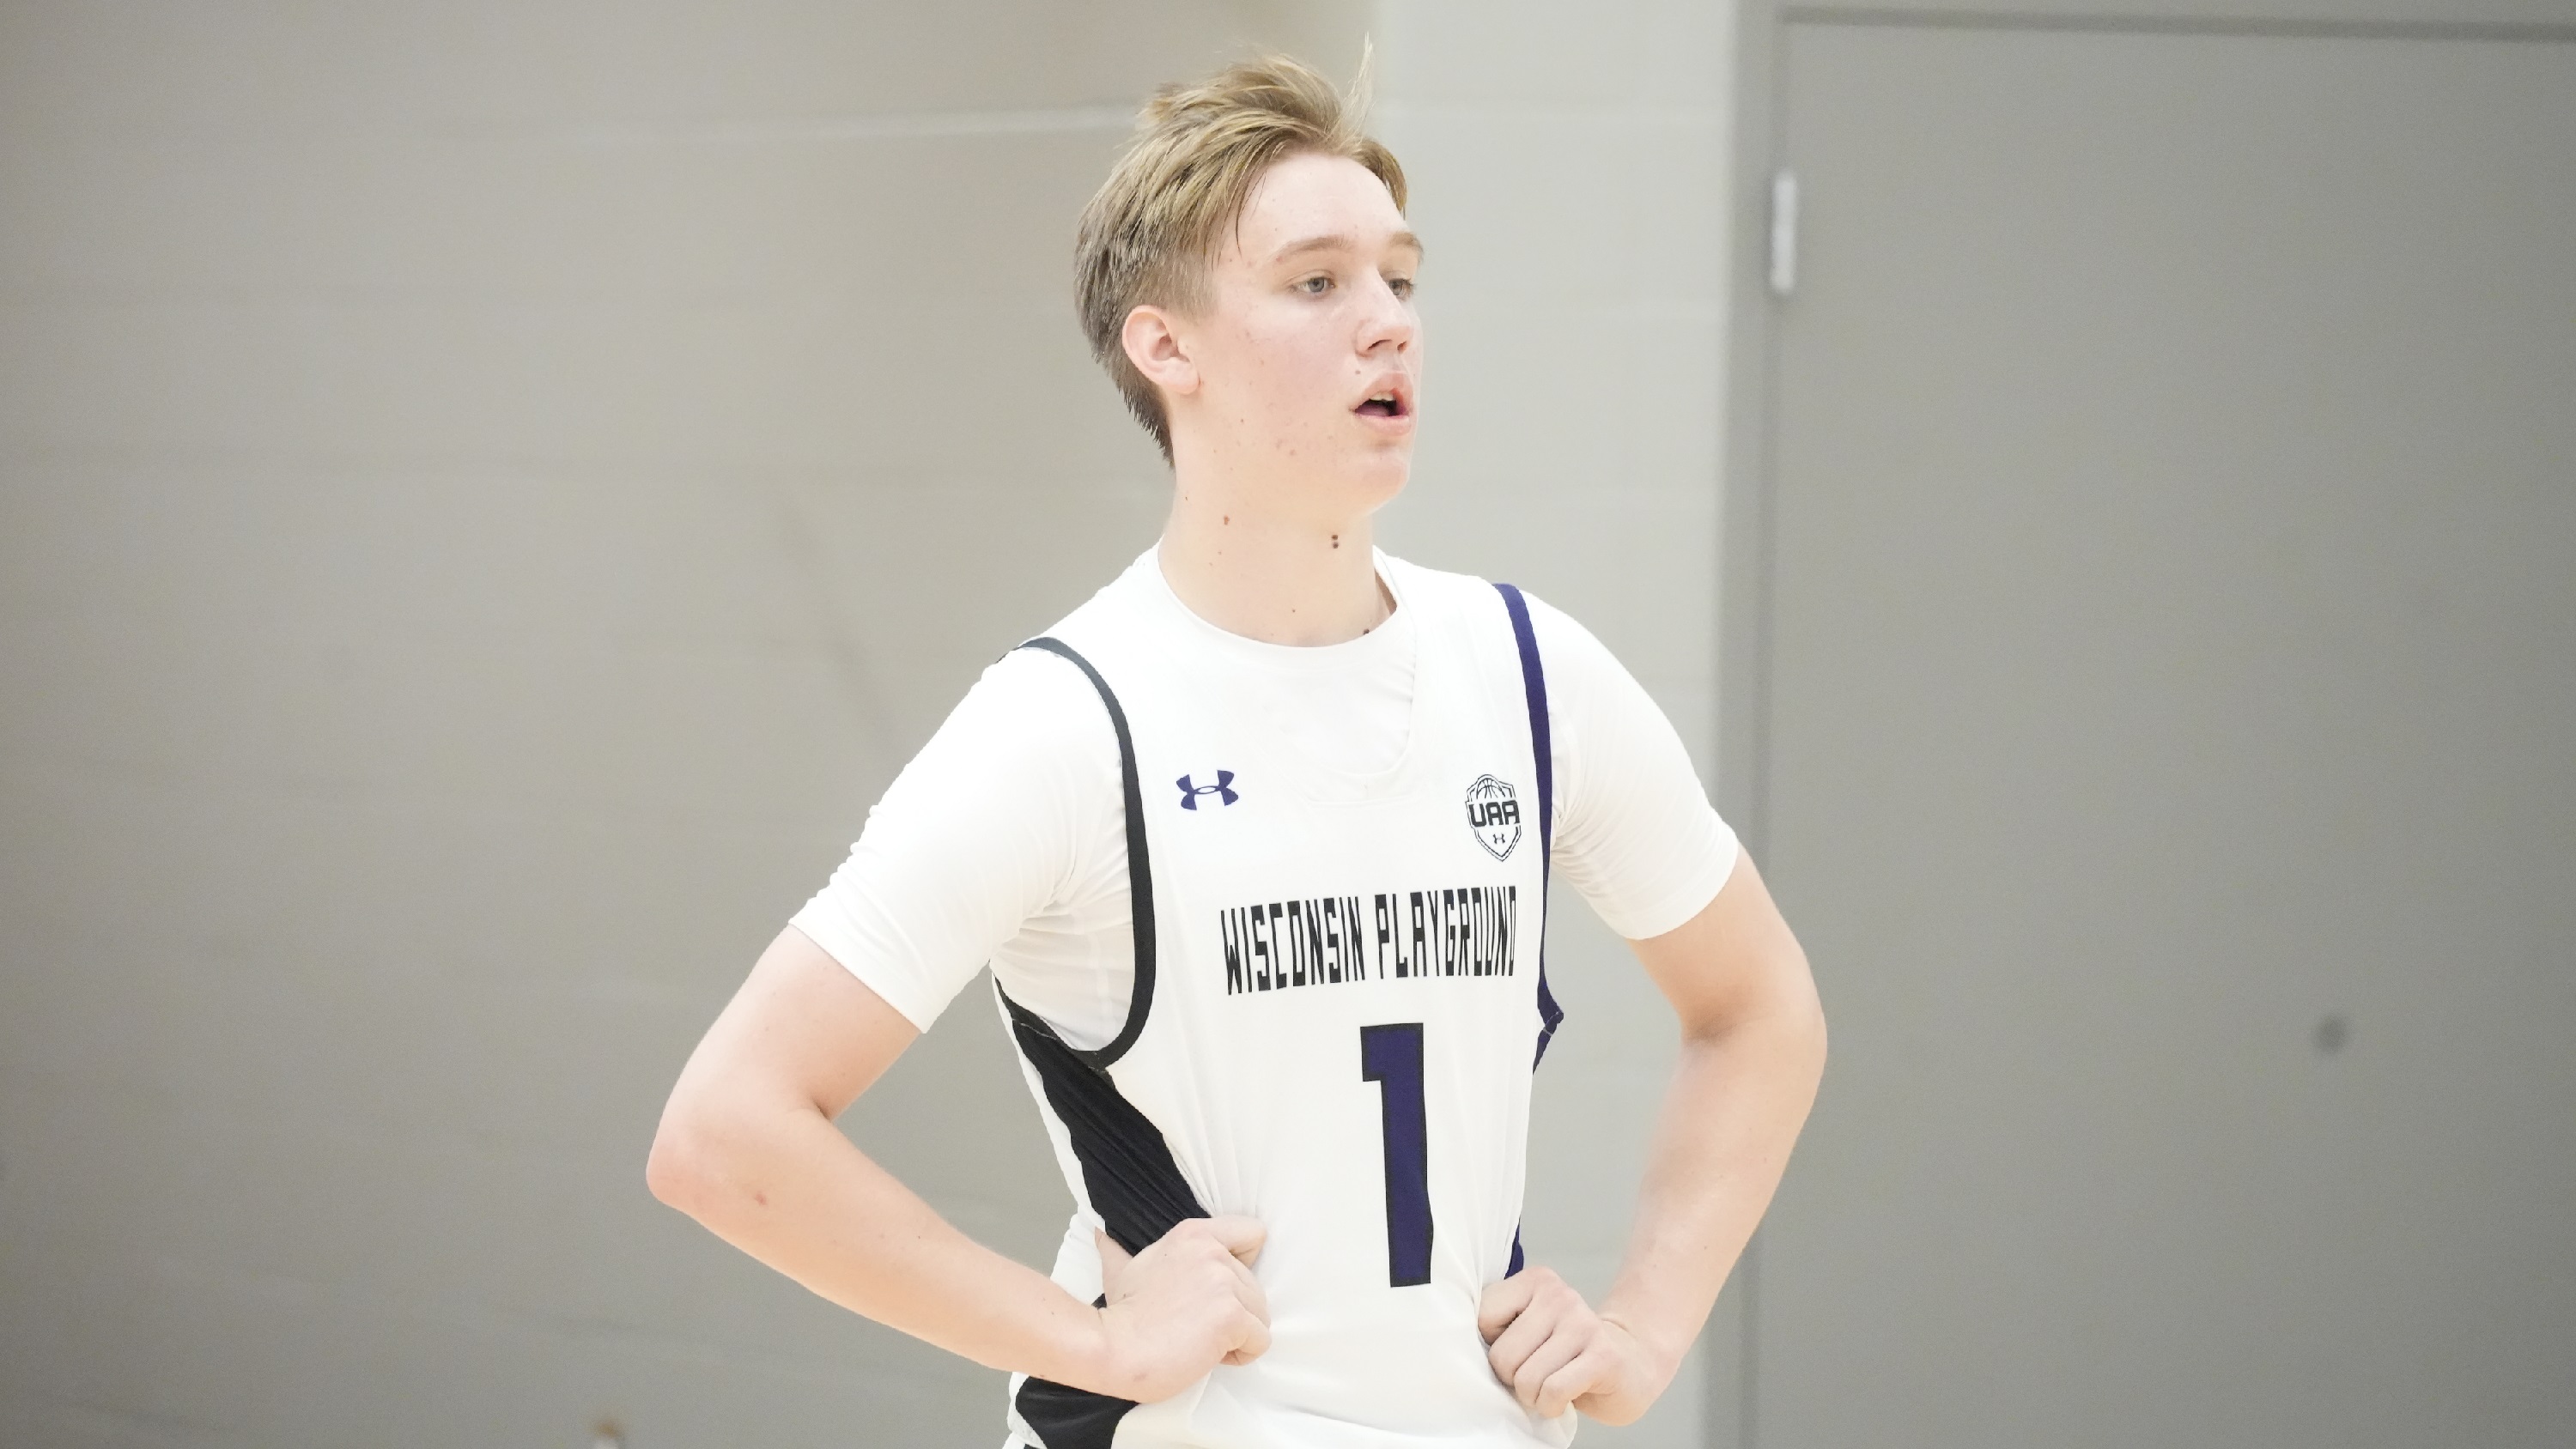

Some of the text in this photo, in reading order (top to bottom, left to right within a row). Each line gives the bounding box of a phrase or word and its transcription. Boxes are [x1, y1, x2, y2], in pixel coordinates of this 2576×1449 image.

[1468, 799, 1521, 828] UAA
[1220, 885, 1516, 996] WISCONSIN PLAYGROUND
[1359, 1022, 1435, 1288] 1
